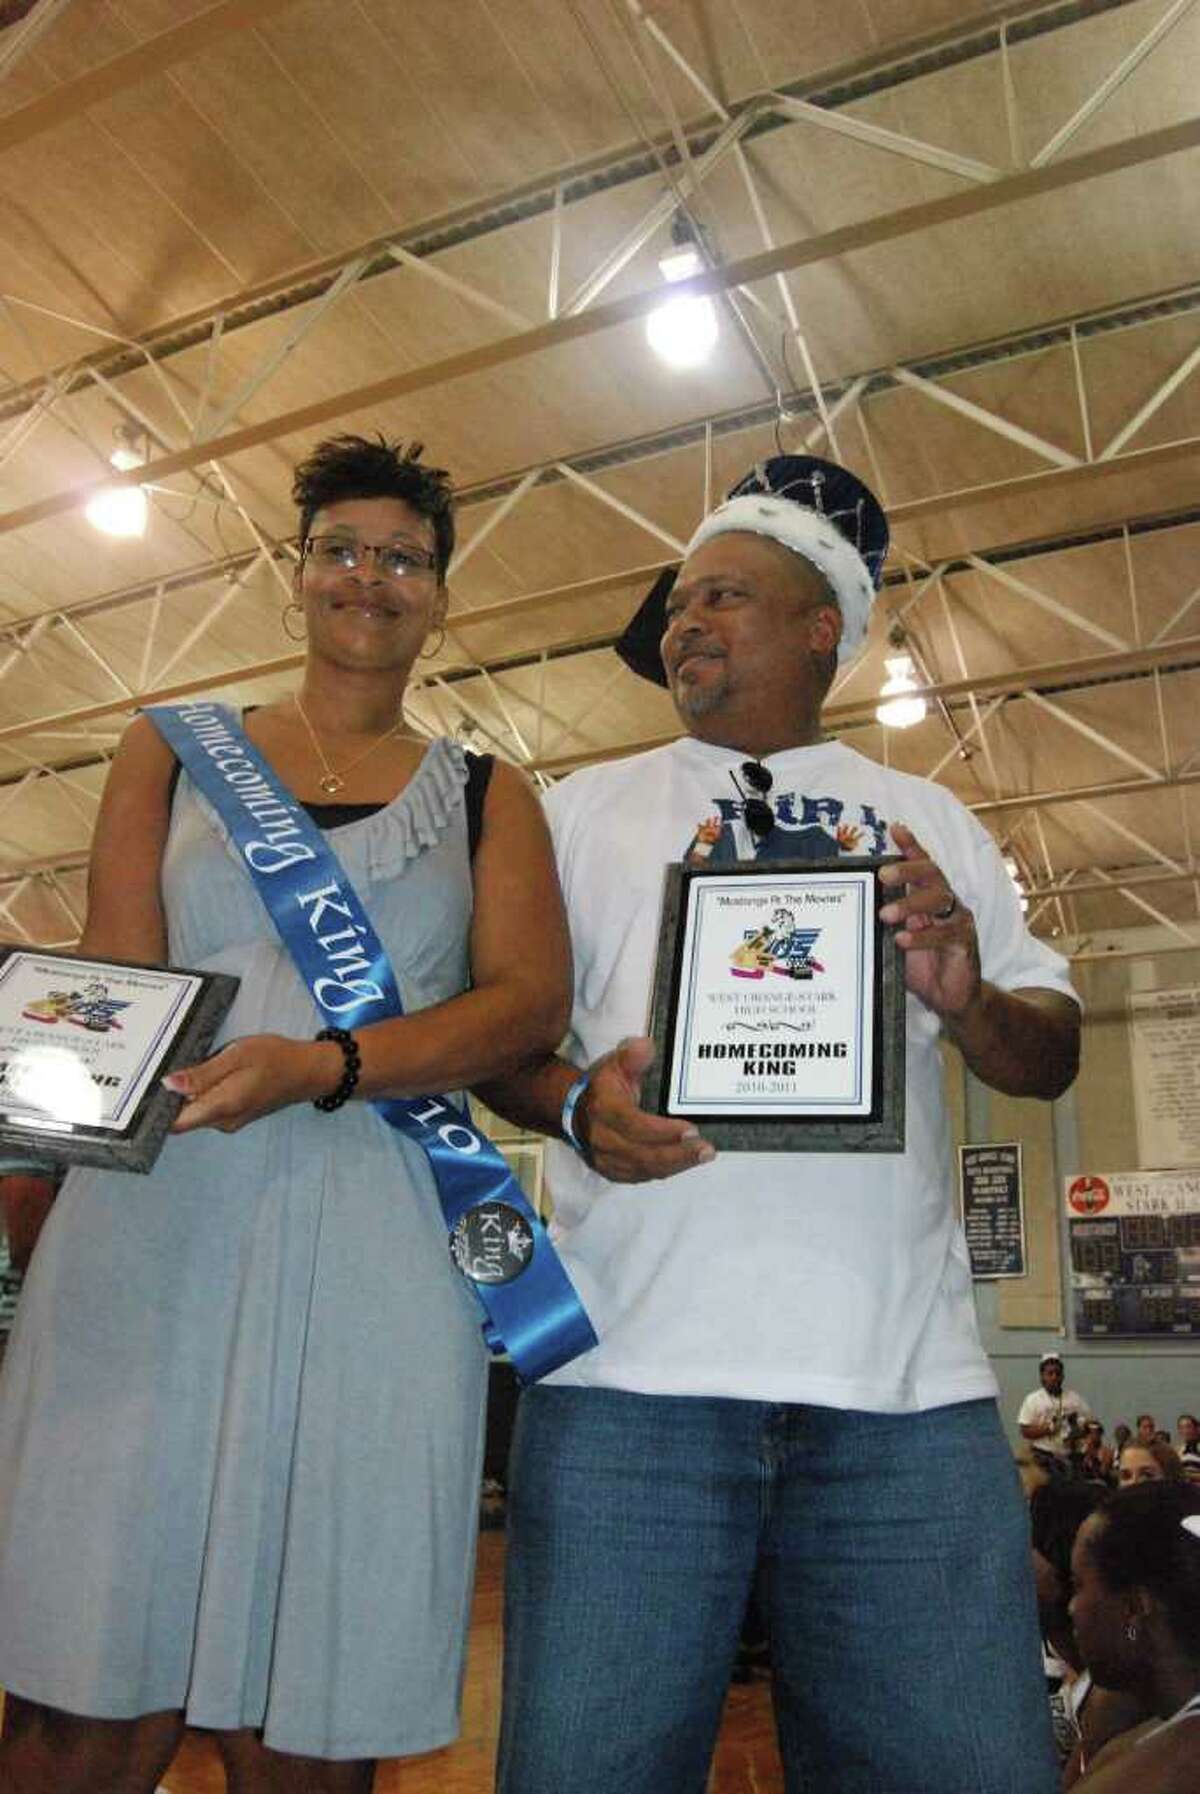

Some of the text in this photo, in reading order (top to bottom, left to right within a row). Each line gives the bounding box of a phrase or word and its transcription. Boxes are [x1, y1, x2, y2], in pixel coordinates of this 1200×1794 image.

[296, 879, 385, 1013] King
[697, 1042, 848, 1060] HOMECOMING
[743, 1060, 797, 1077] KING
[735, 1081, 799, 1094] 2010-2011
[472, 1213, 504, 1278] King
